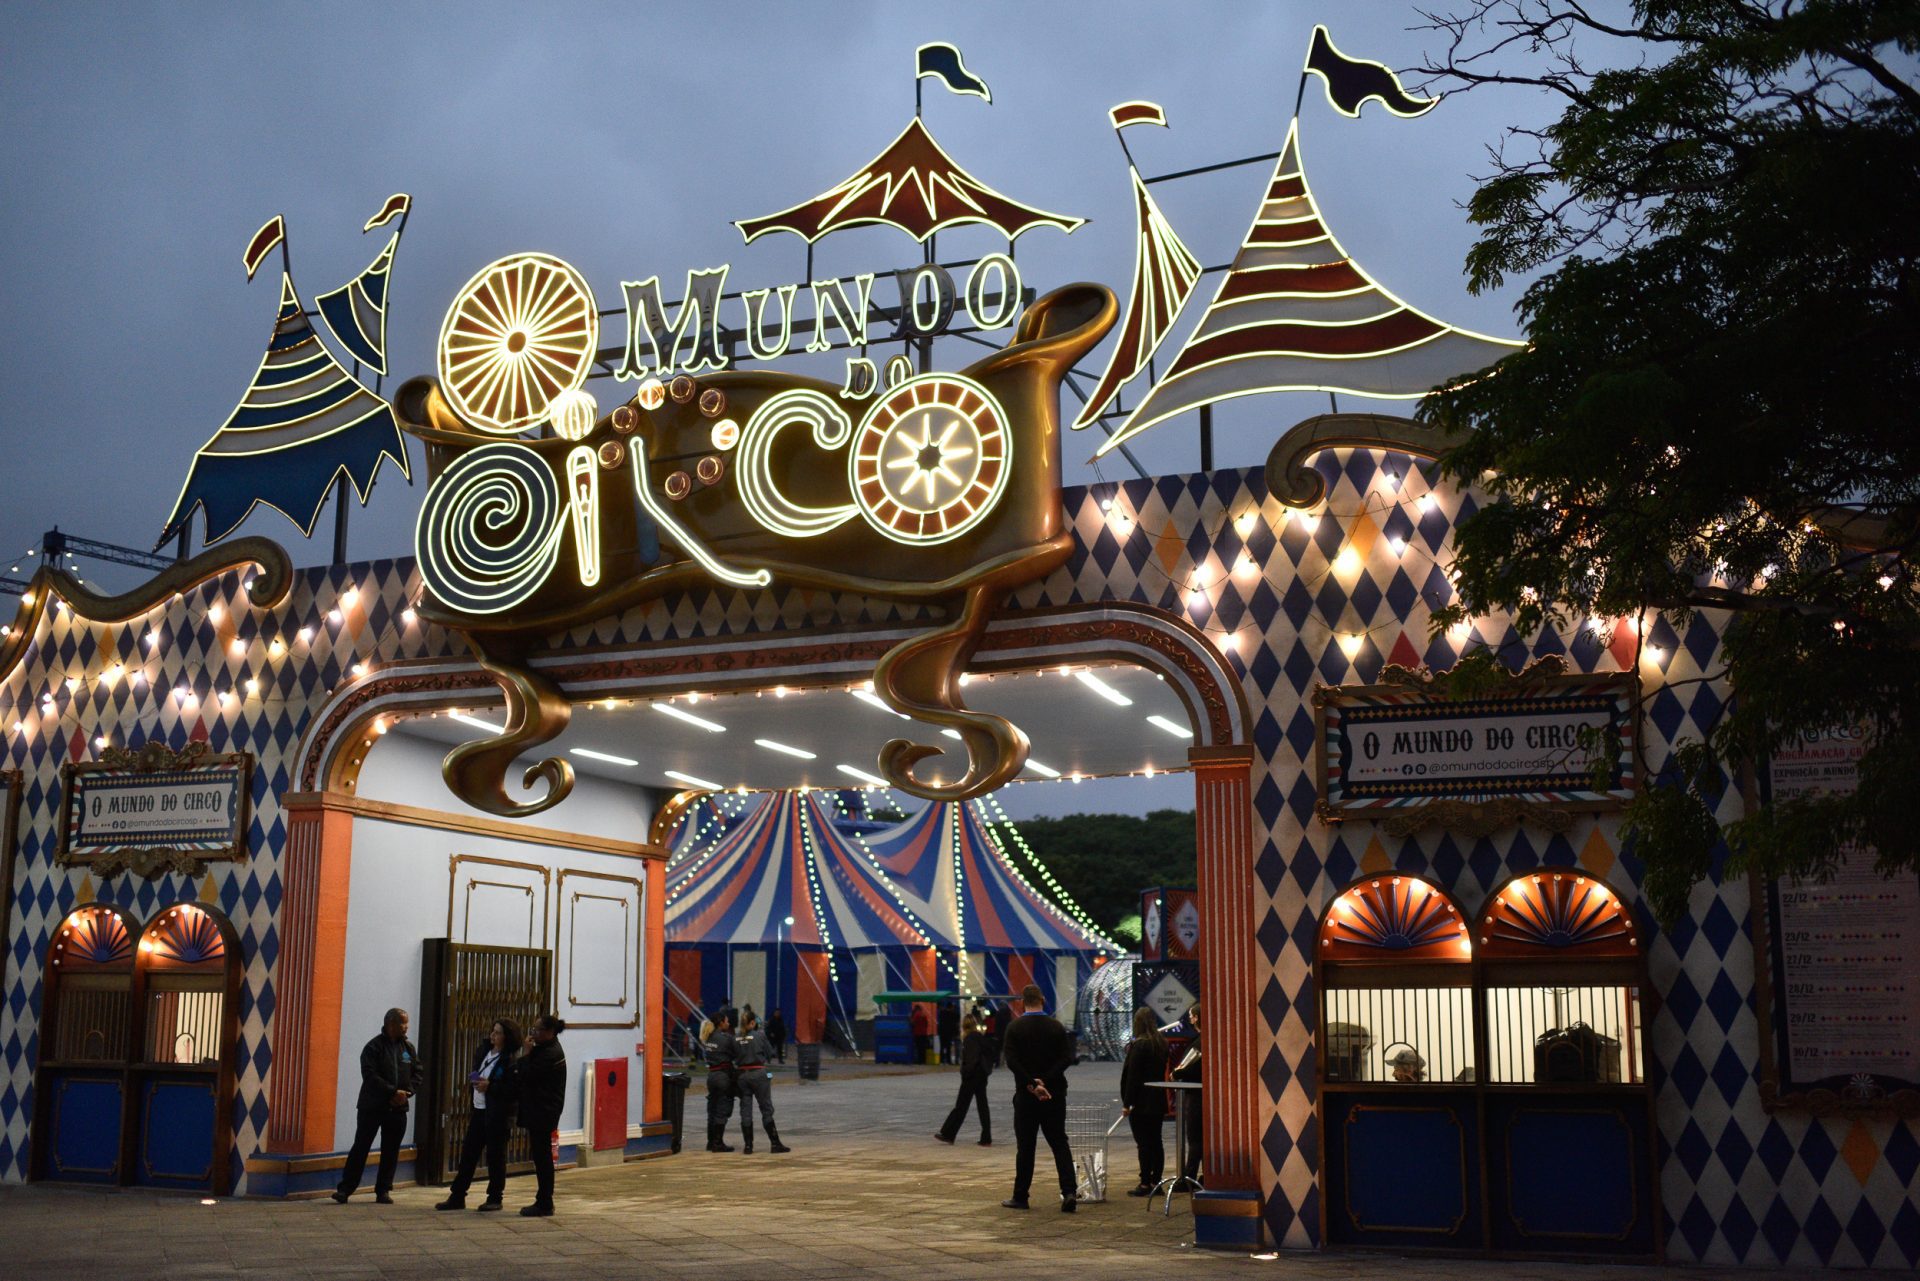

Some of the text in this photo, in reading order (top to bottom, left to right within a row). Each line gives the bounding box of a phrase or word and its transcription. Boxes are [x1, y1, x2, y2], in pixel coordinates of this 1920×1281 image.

[614, 251, 1023, 383] MUNDO
[840, 355, 914, 400] DO
[1363, 721, 1591, 760] O MUNDO DO CIRCO
[1774, 764, 1855, 778] EXPOSIÇÃO MUNDO
[92, 790, 222, 818] O MUNDO DO CIRCO
[1782, 893, 1808, 904] 22/12
[1784, 931, 1810, 942] 23/12
[1786, 954, 1813, 965] 27/12
[1788, 983, 1815, 995] 28/12
[1790, 1012, 1816, 1024] 29/12
[1793, 1047, 1818, 1058] 30/12
